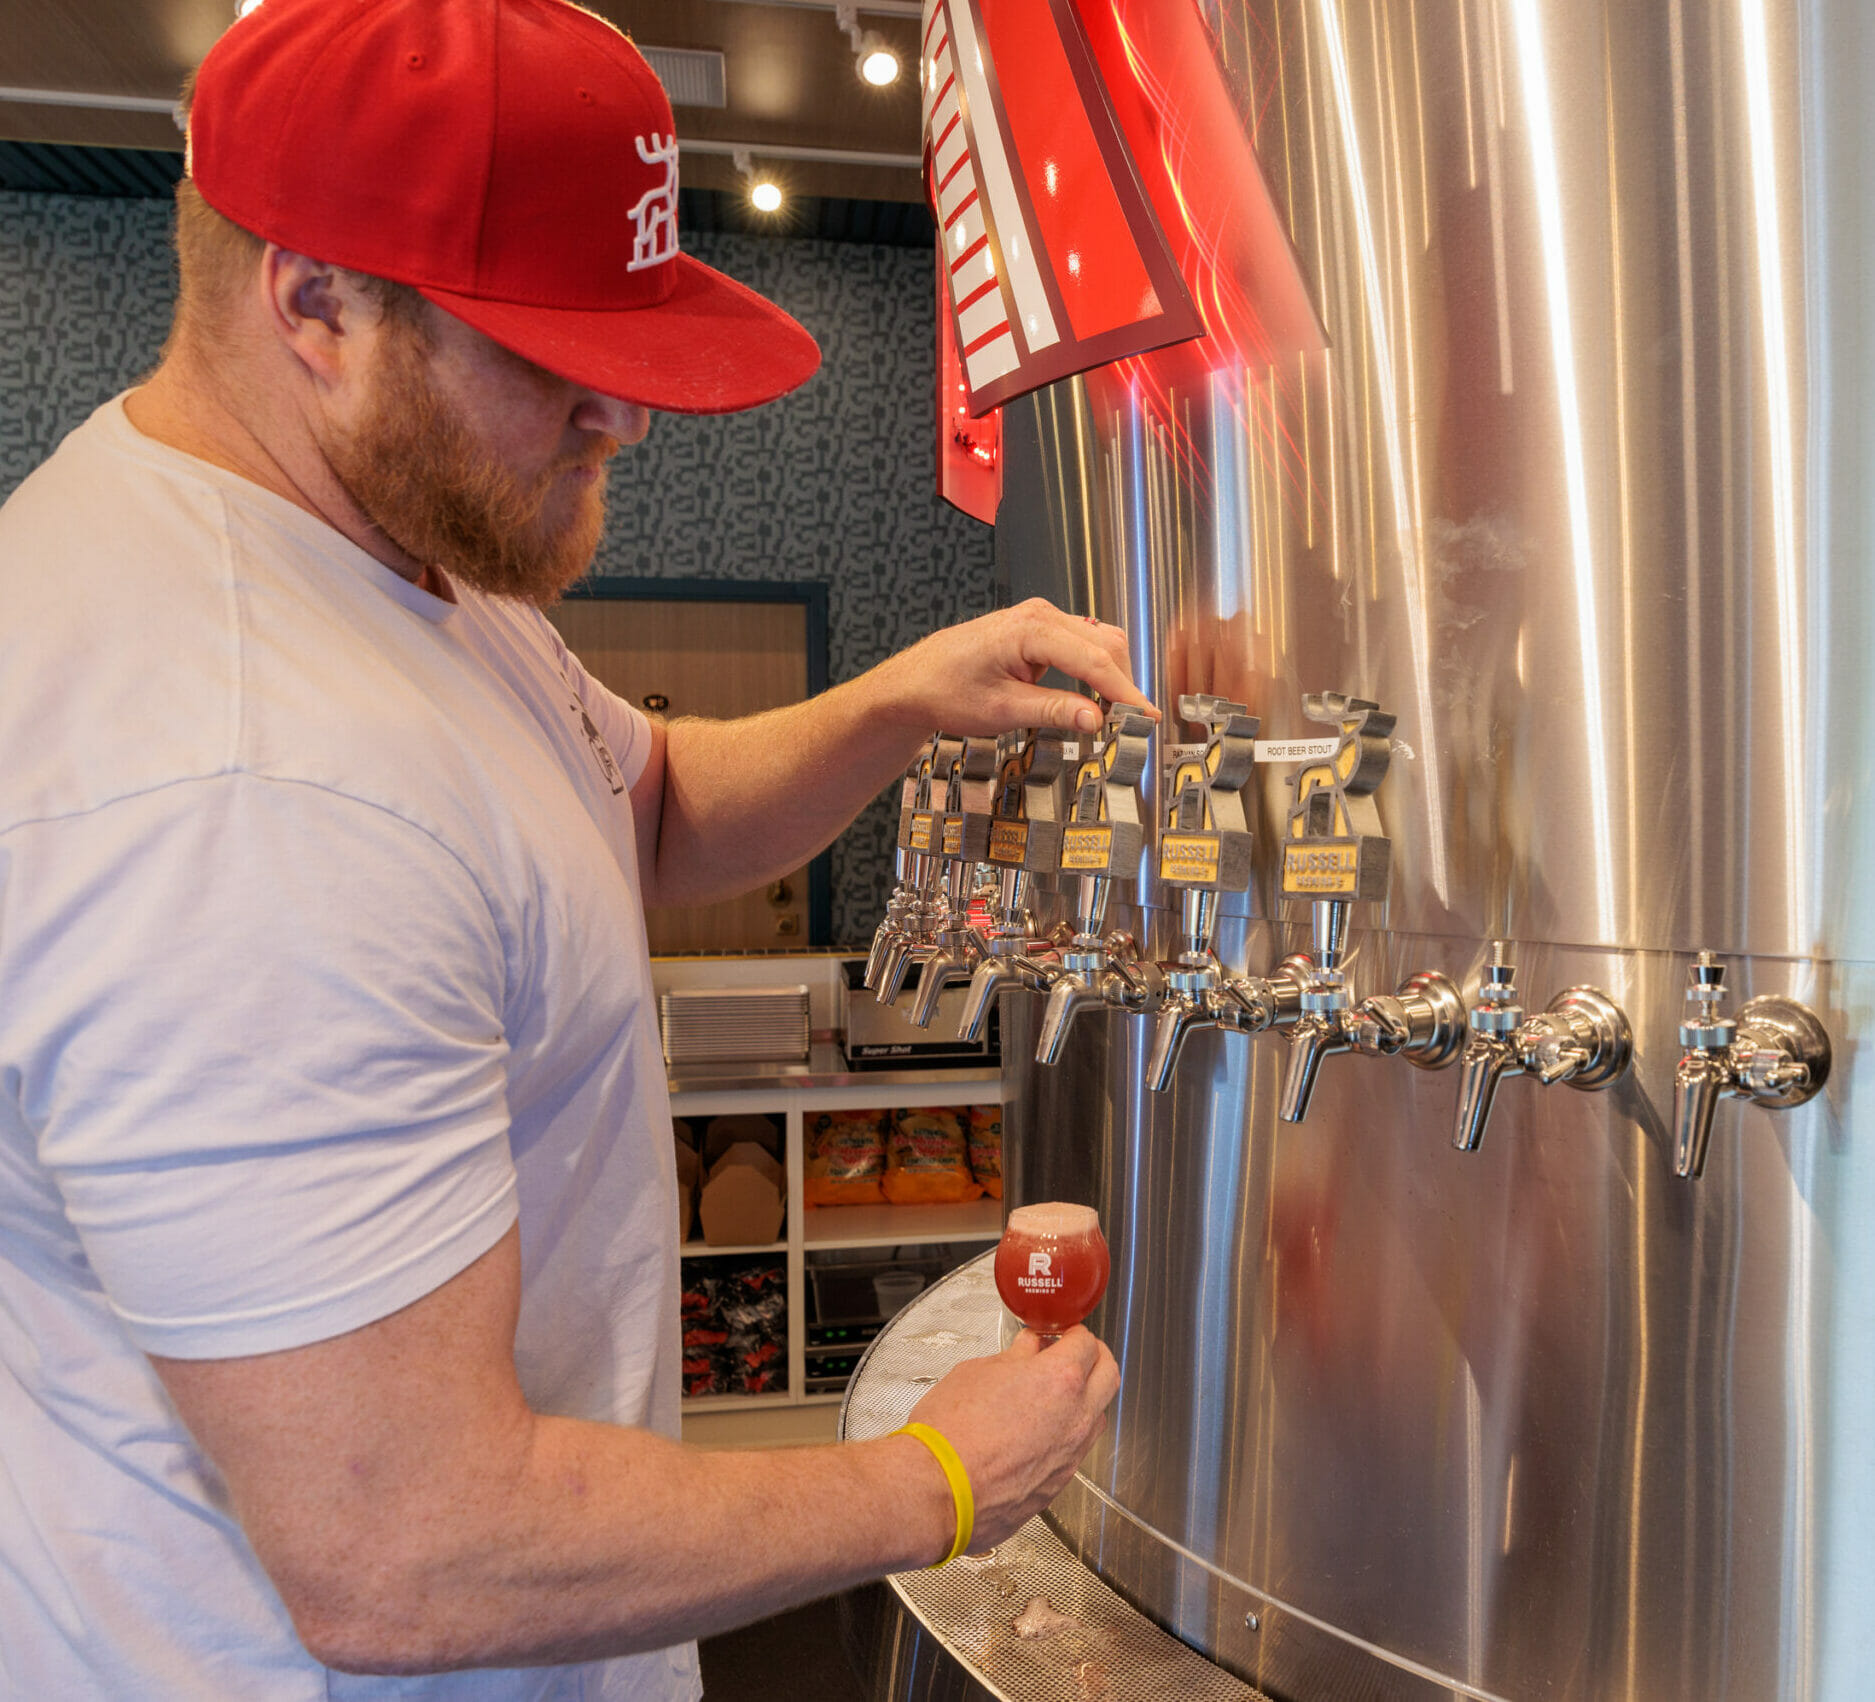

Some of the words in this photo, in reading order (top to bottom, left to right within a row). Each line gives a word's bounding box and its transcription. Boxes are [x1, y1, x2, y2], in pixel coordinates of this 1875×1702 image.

[1267, 746, 1286, 756] ROOT
[1288, 745, 1306, 756] BEER
[1308, 744, 1332, 755] STOUT
[1162, 843, 1218, 863] RUSSELL
[1286, 852, 1353, 873] RUSSELL
[861, 1046, 889, 1057] Super
[1029, 1252, 1052, 1276] R
[1018, 1277, 1063, 1288] RUSSELL
